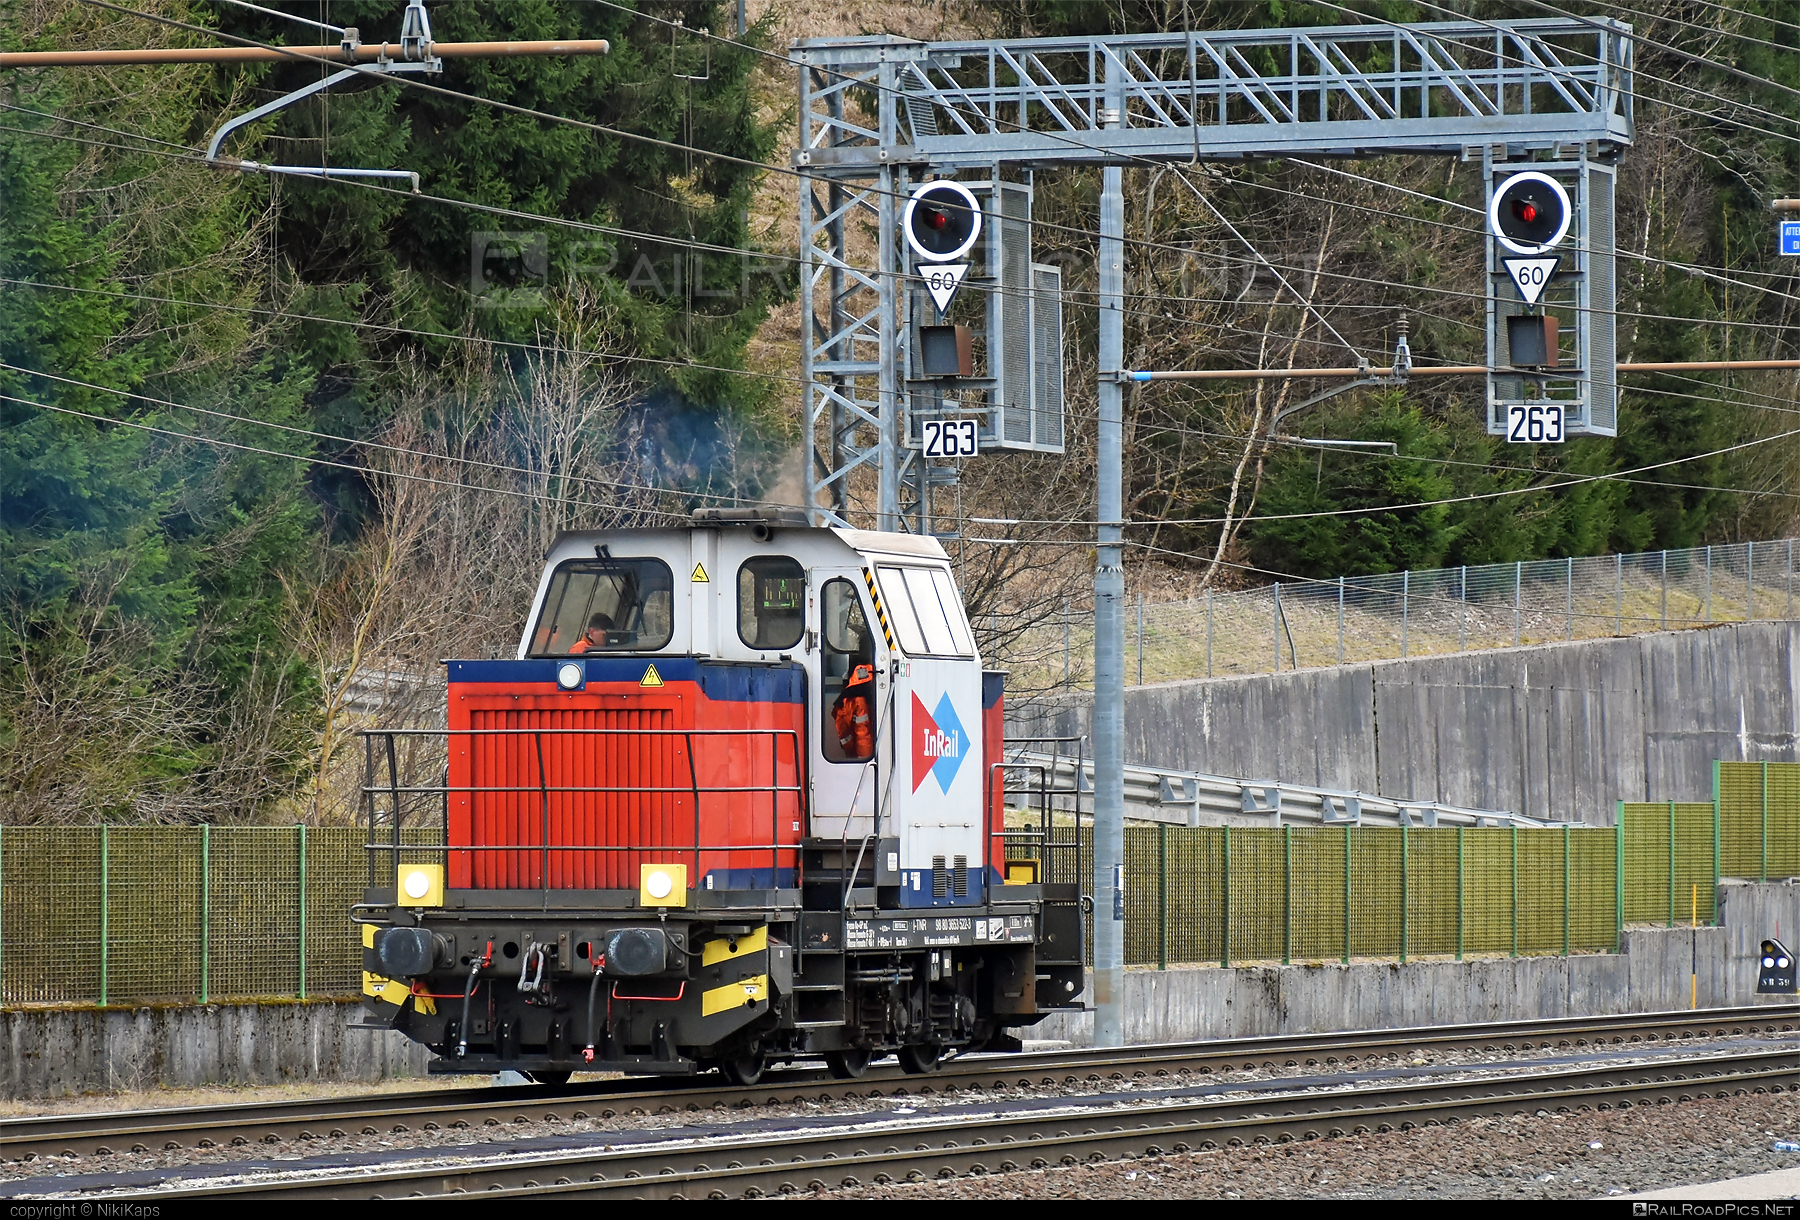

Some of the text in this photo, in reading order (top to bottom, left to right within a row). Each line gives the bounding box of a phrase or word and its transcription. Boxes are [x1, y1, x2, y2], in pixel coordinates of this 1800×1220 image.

[1785, 226, 1800, 236] ATTE
[930, 271, 955, 291] 60
[1518, 266, 1544, 286] 60
[1510, 406, 1562, 442] 263
[925, 421, 976, 457] 263
[923, 728, 959, 758] InRail
